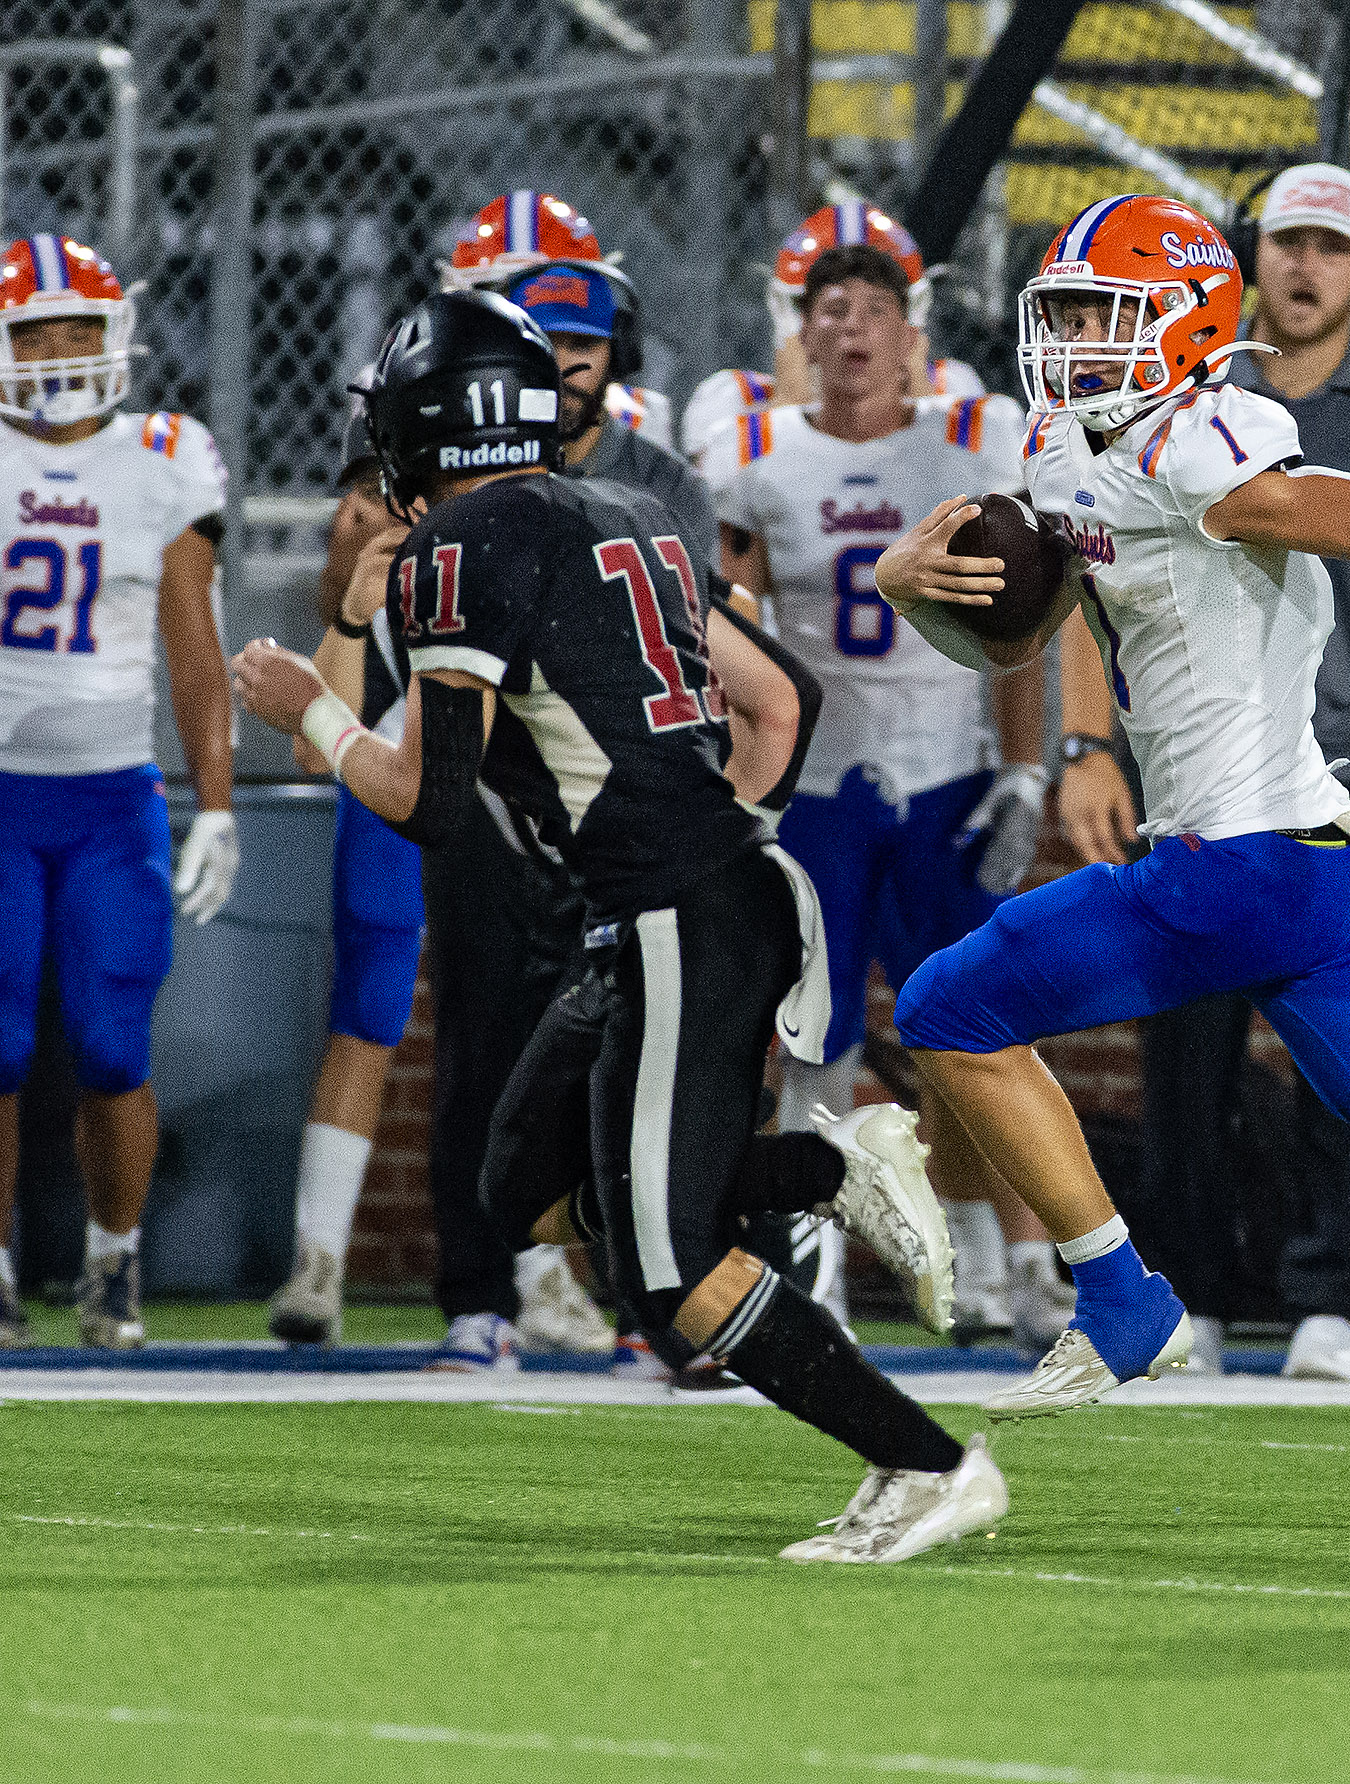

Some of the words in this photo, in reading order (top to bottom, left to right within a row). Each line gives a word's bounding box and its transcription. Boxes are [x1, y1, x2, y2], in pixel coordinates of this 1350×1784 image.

[1047, 263, 1085, 275] Riddell
[1160, 231, 1235, 270] Saints
[466, 379, 506, 426] 11
[438, 440, 541, 469] Riddell
[1210, 415, 1249, 466] 1
[1, 536, 103, 653] 21
[398, 543, 466, 638] 11
[592, 535, 730, 733] 11
